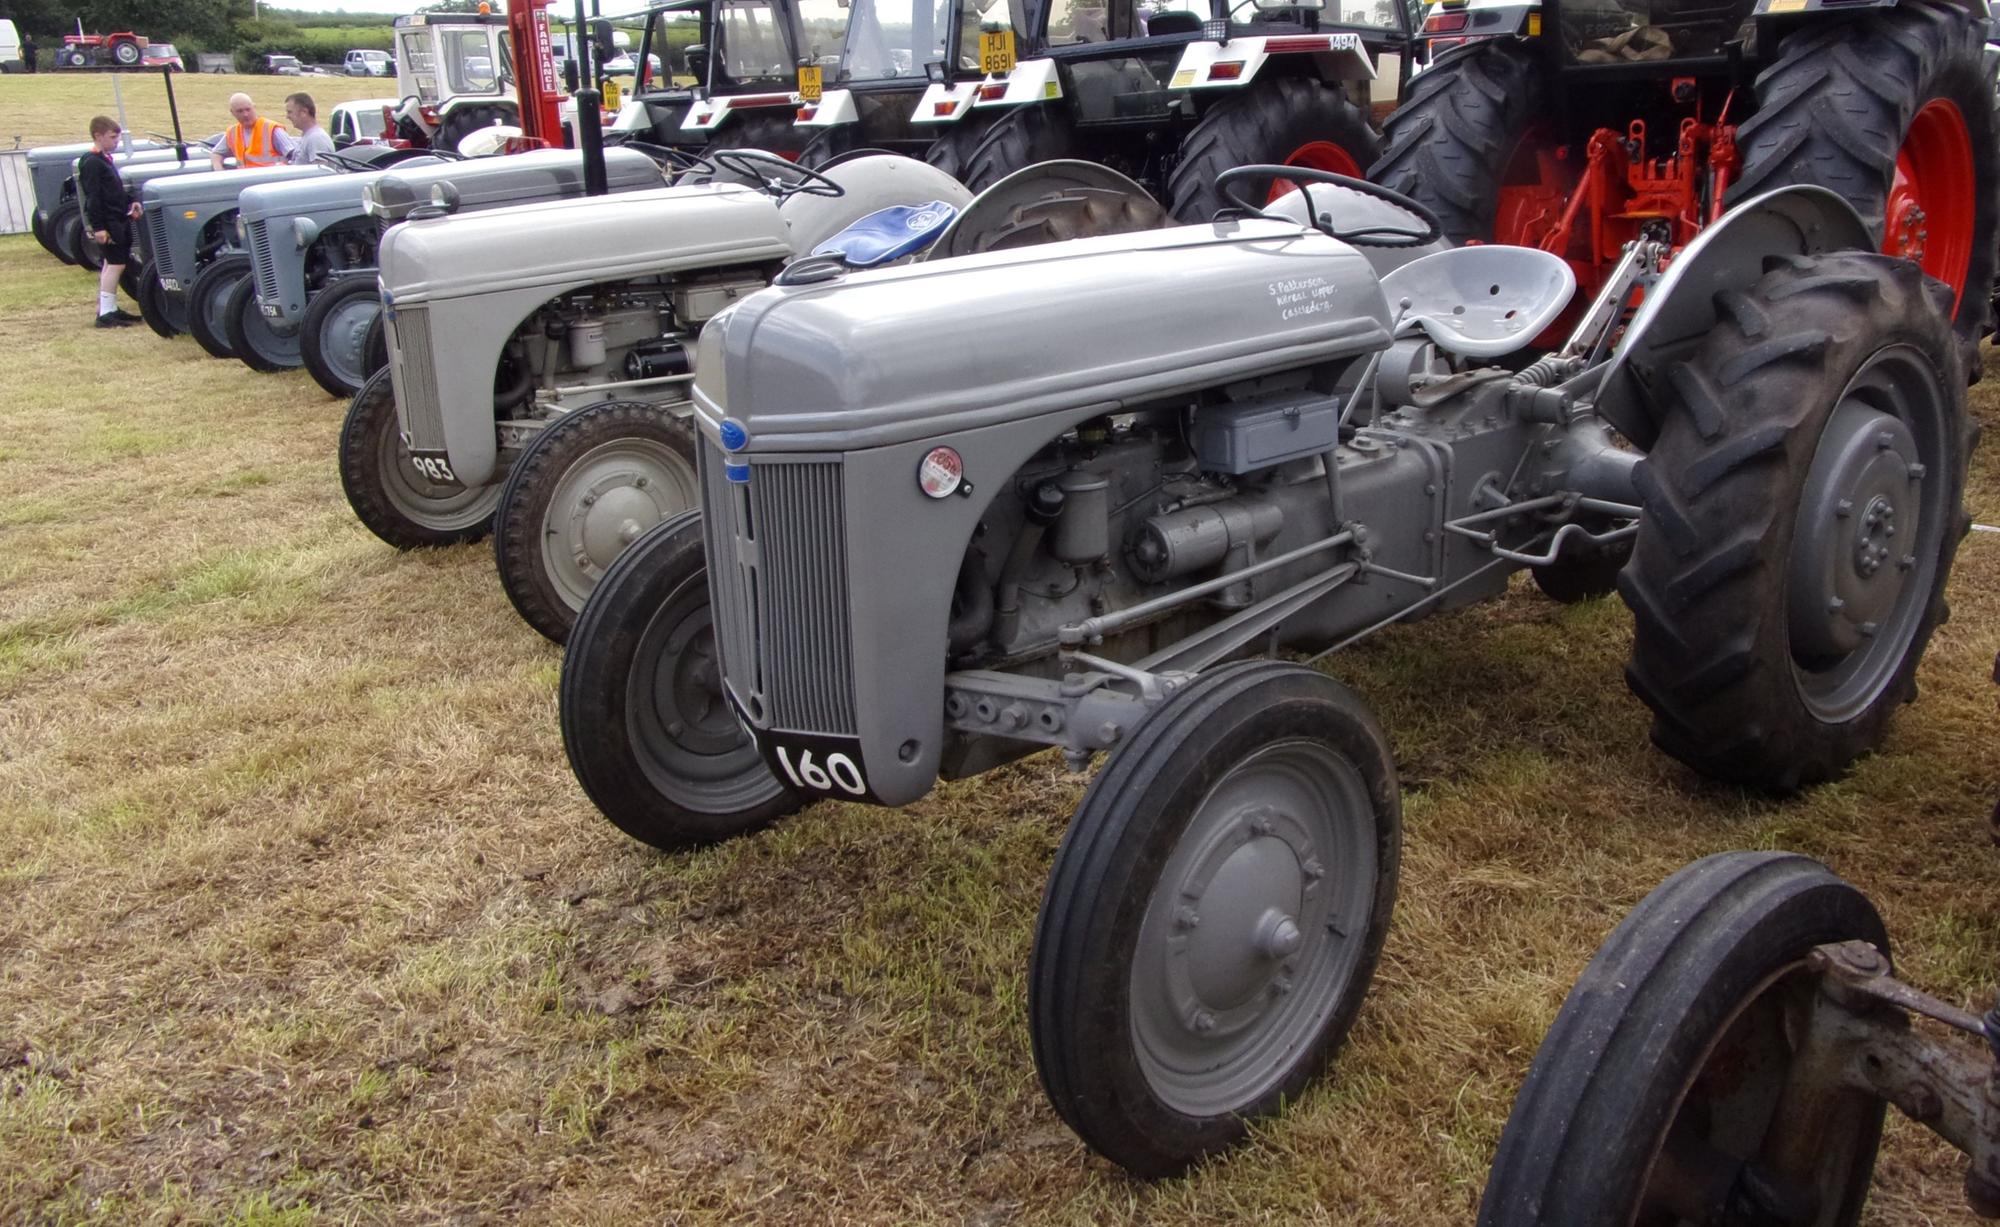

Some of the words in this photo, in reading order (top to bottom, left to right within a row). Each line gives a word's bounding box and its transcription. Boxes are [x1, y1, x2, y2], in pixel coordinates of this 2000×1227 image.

[987, 33, 1007, 51] HJI
[1329, 35, 1356, 51] 1494
[985, 53, 1012, 71] 8691
[412, 456, 455, 481] 983
[776, 745, 866, 795] 160
